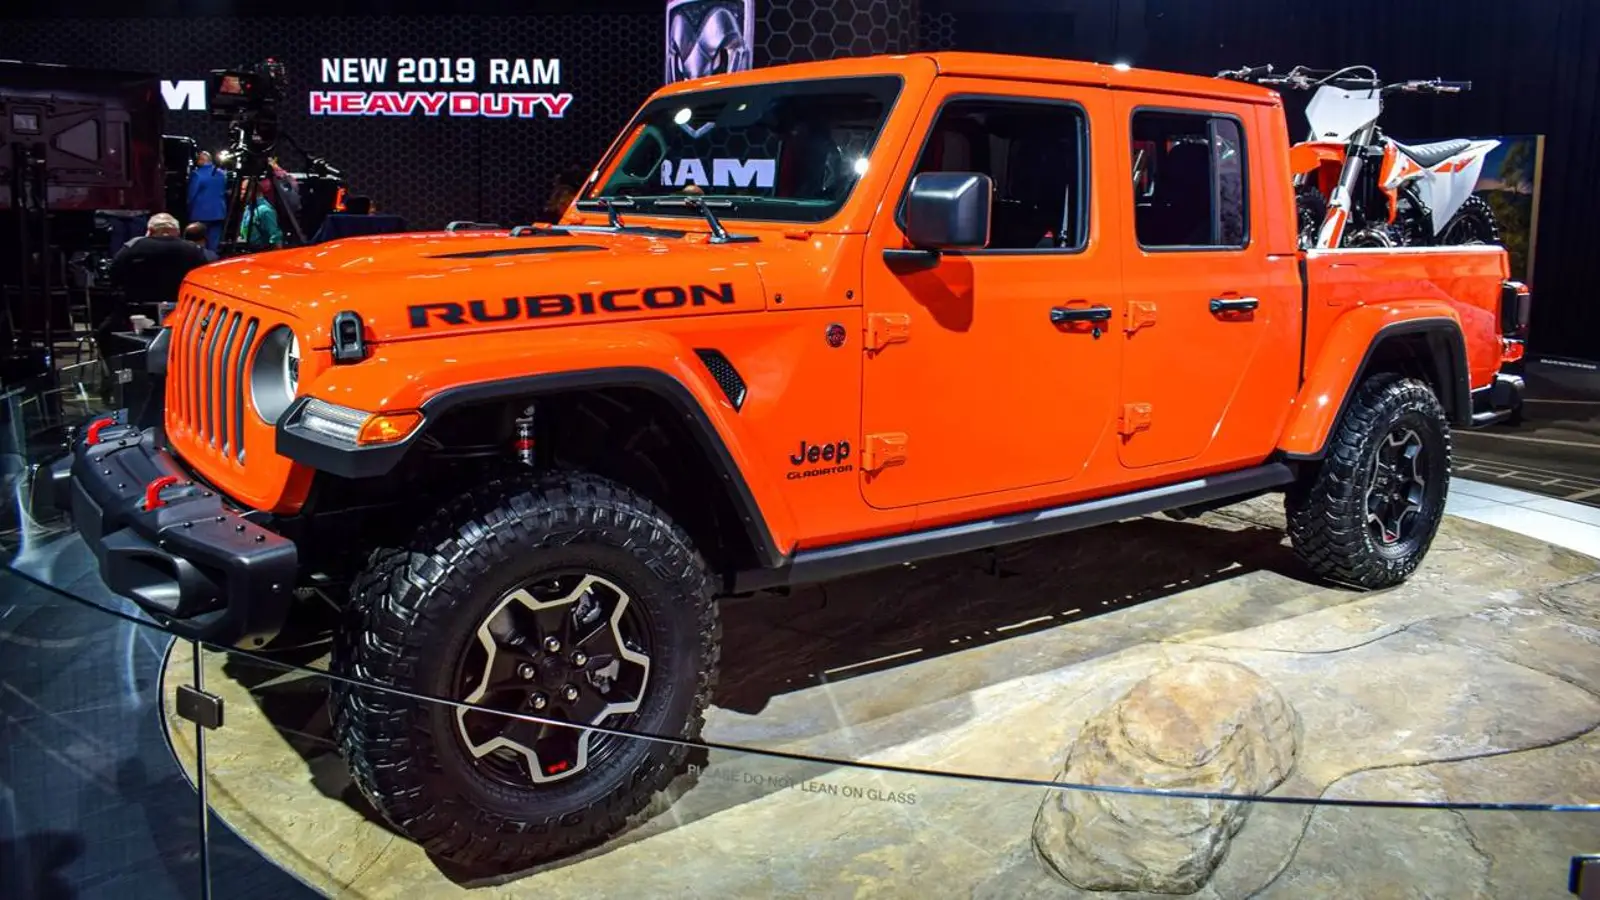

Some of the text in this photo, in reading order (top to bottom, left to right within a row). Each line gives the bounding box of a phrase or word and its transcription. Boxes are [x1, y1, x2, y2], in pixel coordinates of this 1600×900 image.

[321, 57, 560, 84] NEW 2019 RAM
[309, 91, 573, 118] HEAVY DUTY
[407, 283, 736, 329] RUBICON
[790, 440, 850, 465] Jeep
[787, 465, 853, 480] GLADIATOR
[743, 772, 764, 785] DO
[800, 780, 838, 796] LEAN
[841, 785, 864, 799] ON
[866, 788, 917, 806] GLASS
